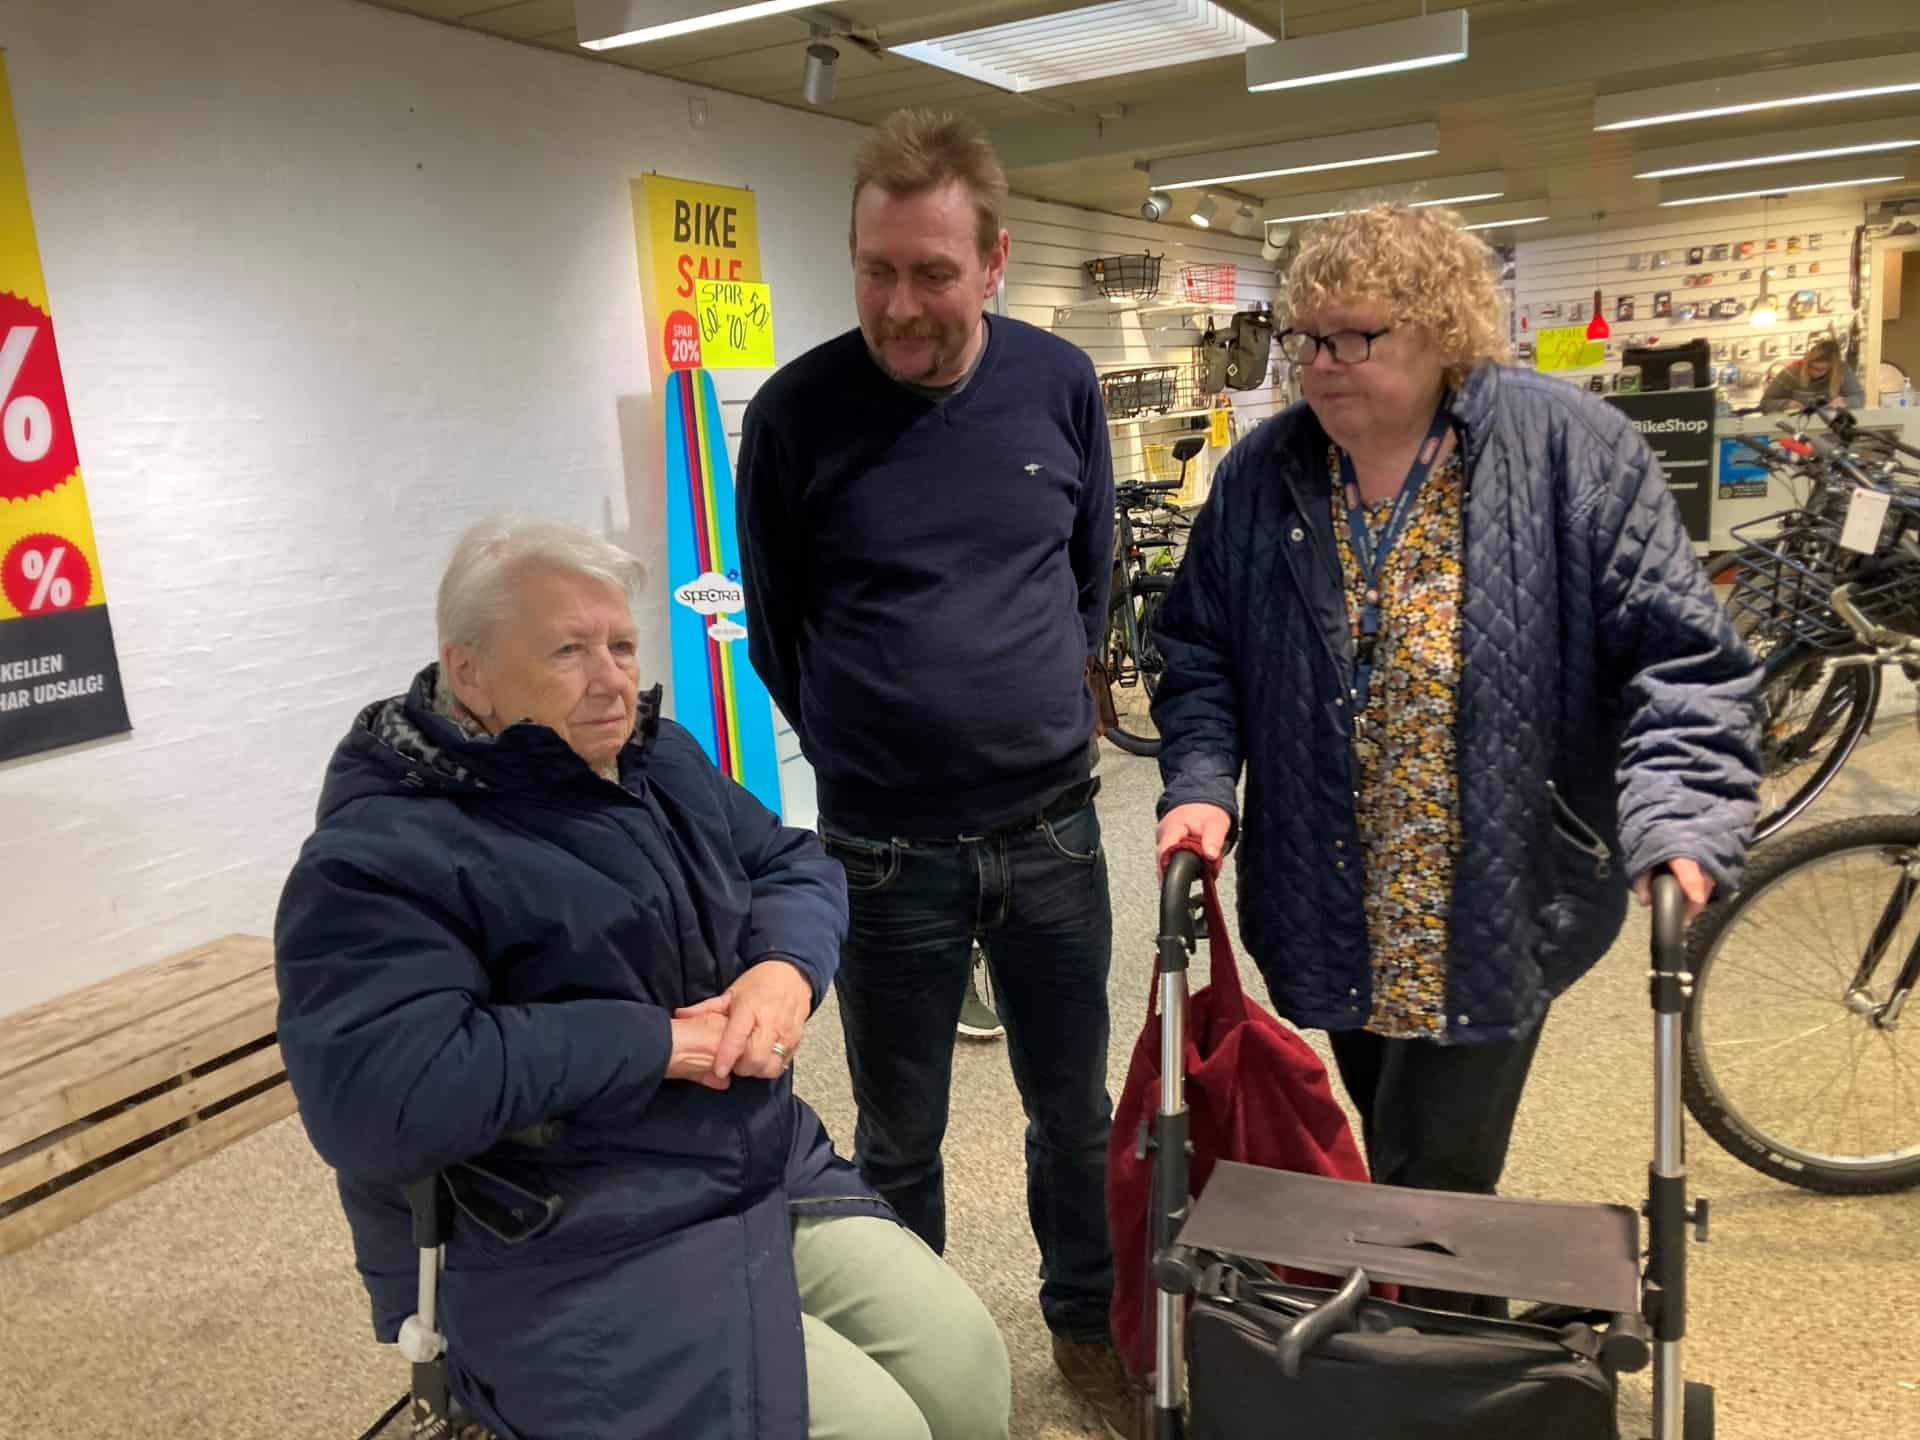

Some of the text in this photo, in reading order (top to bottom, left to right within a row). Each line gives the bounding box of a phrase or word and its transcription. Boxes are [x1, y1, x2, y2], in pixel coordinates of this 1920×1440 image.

[673, 199, 738, 249] BIKE
[699, 282, 743, 306] SPAR
[671, 338, 700, 362] 20%
[1631, 418, 1708, 434] BikeShop
[21, 546, 73, 611] %
[33, 674, 104, 704] UDSALG!
